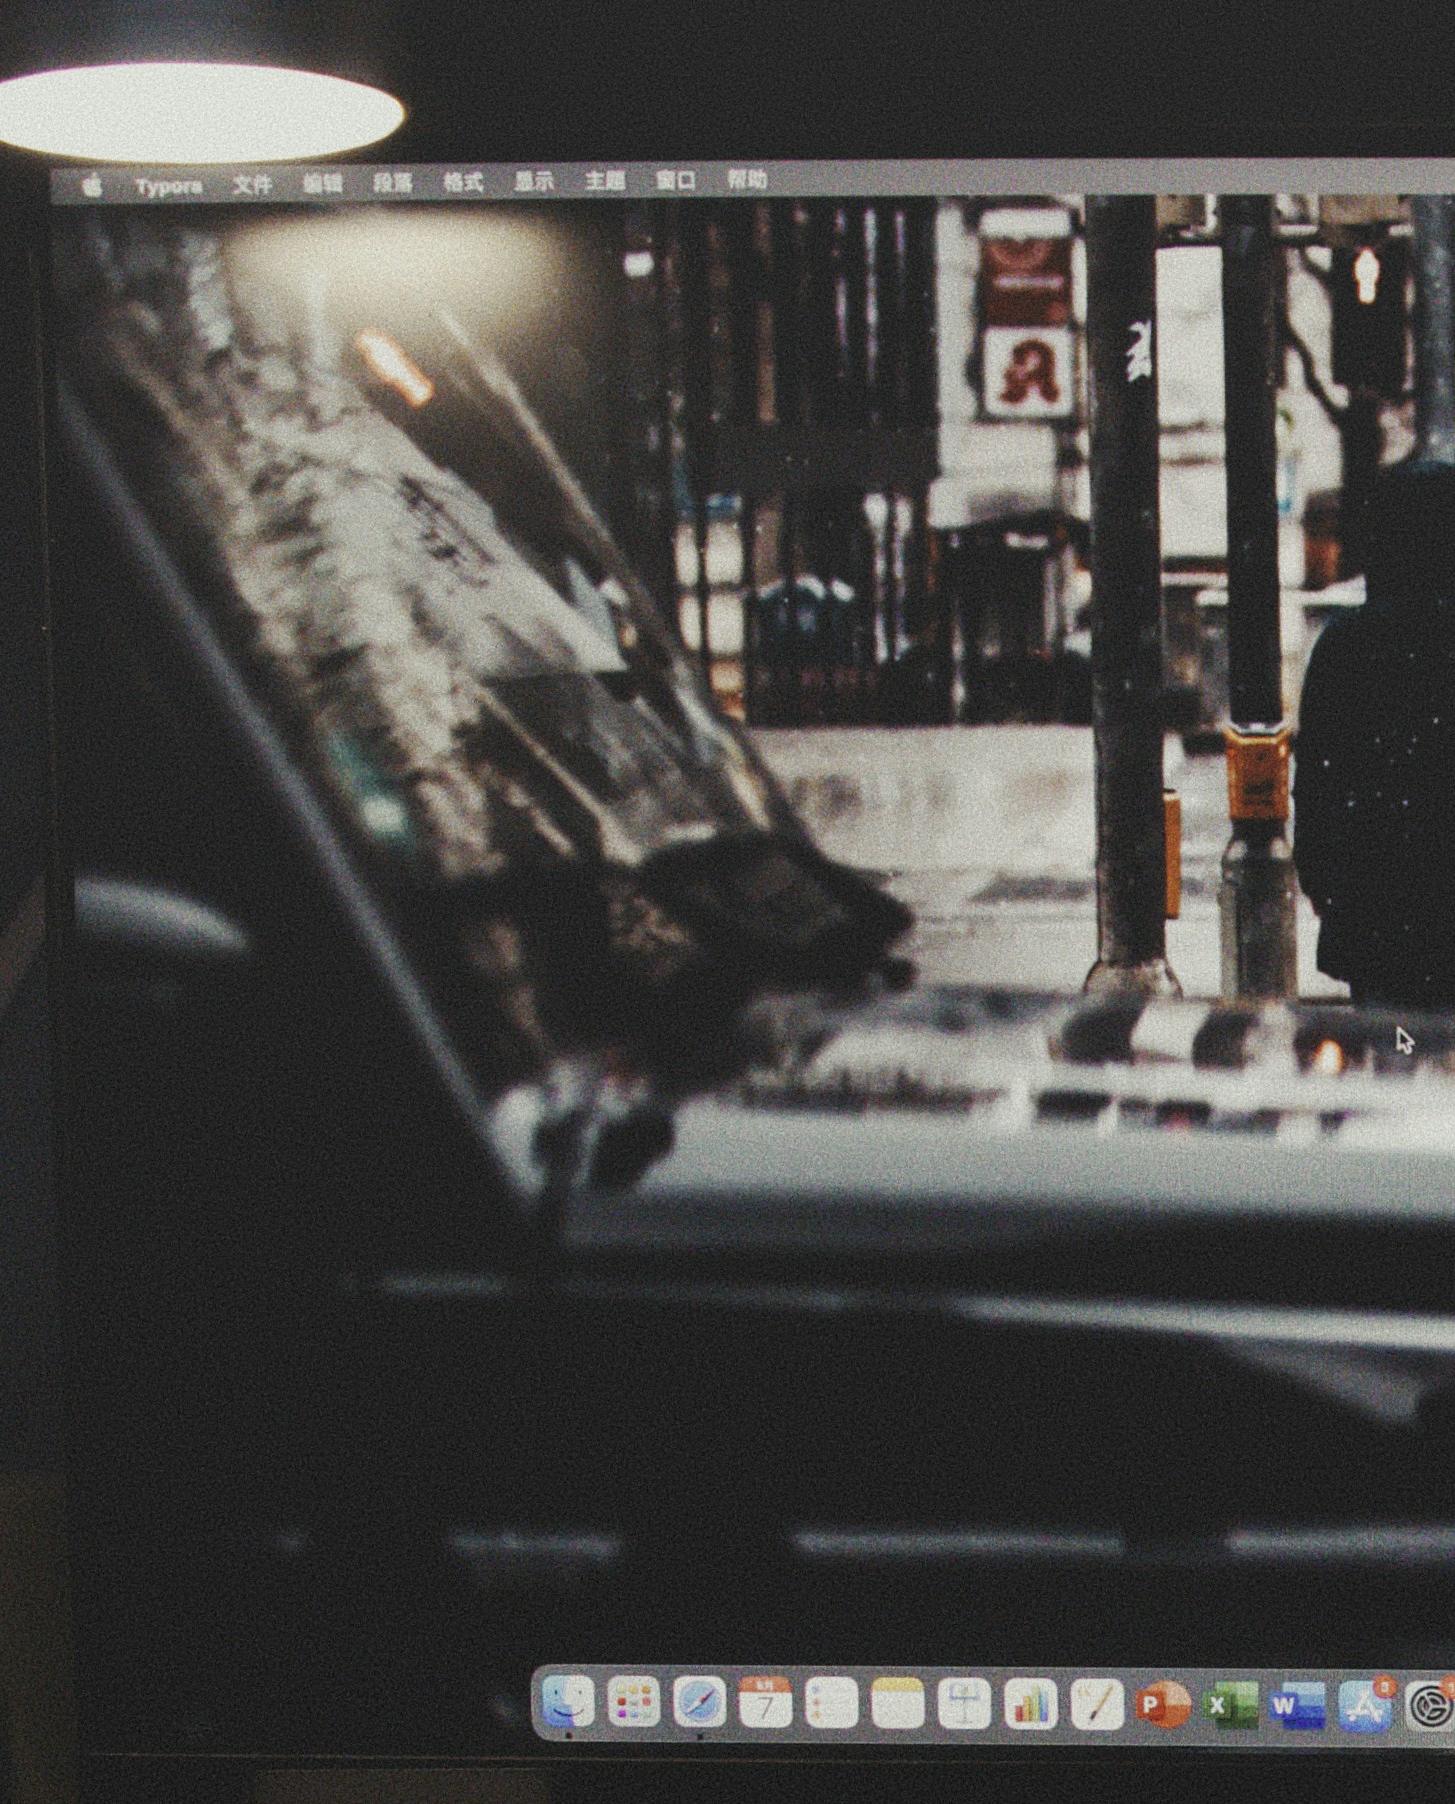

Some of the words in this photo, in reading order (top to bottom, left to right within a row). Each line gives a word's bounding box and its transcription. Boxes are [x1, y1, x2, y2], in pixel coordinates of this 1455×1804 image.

[135, 178, 203, 198] Typora
[233, 175, 273, 194] 文件
[444, 171, 485, 193] 格式
[515, 170, 555, 192] 显示
[585, 170, 626, 191] 主题
[656, 169, 697, 191] 窗口
